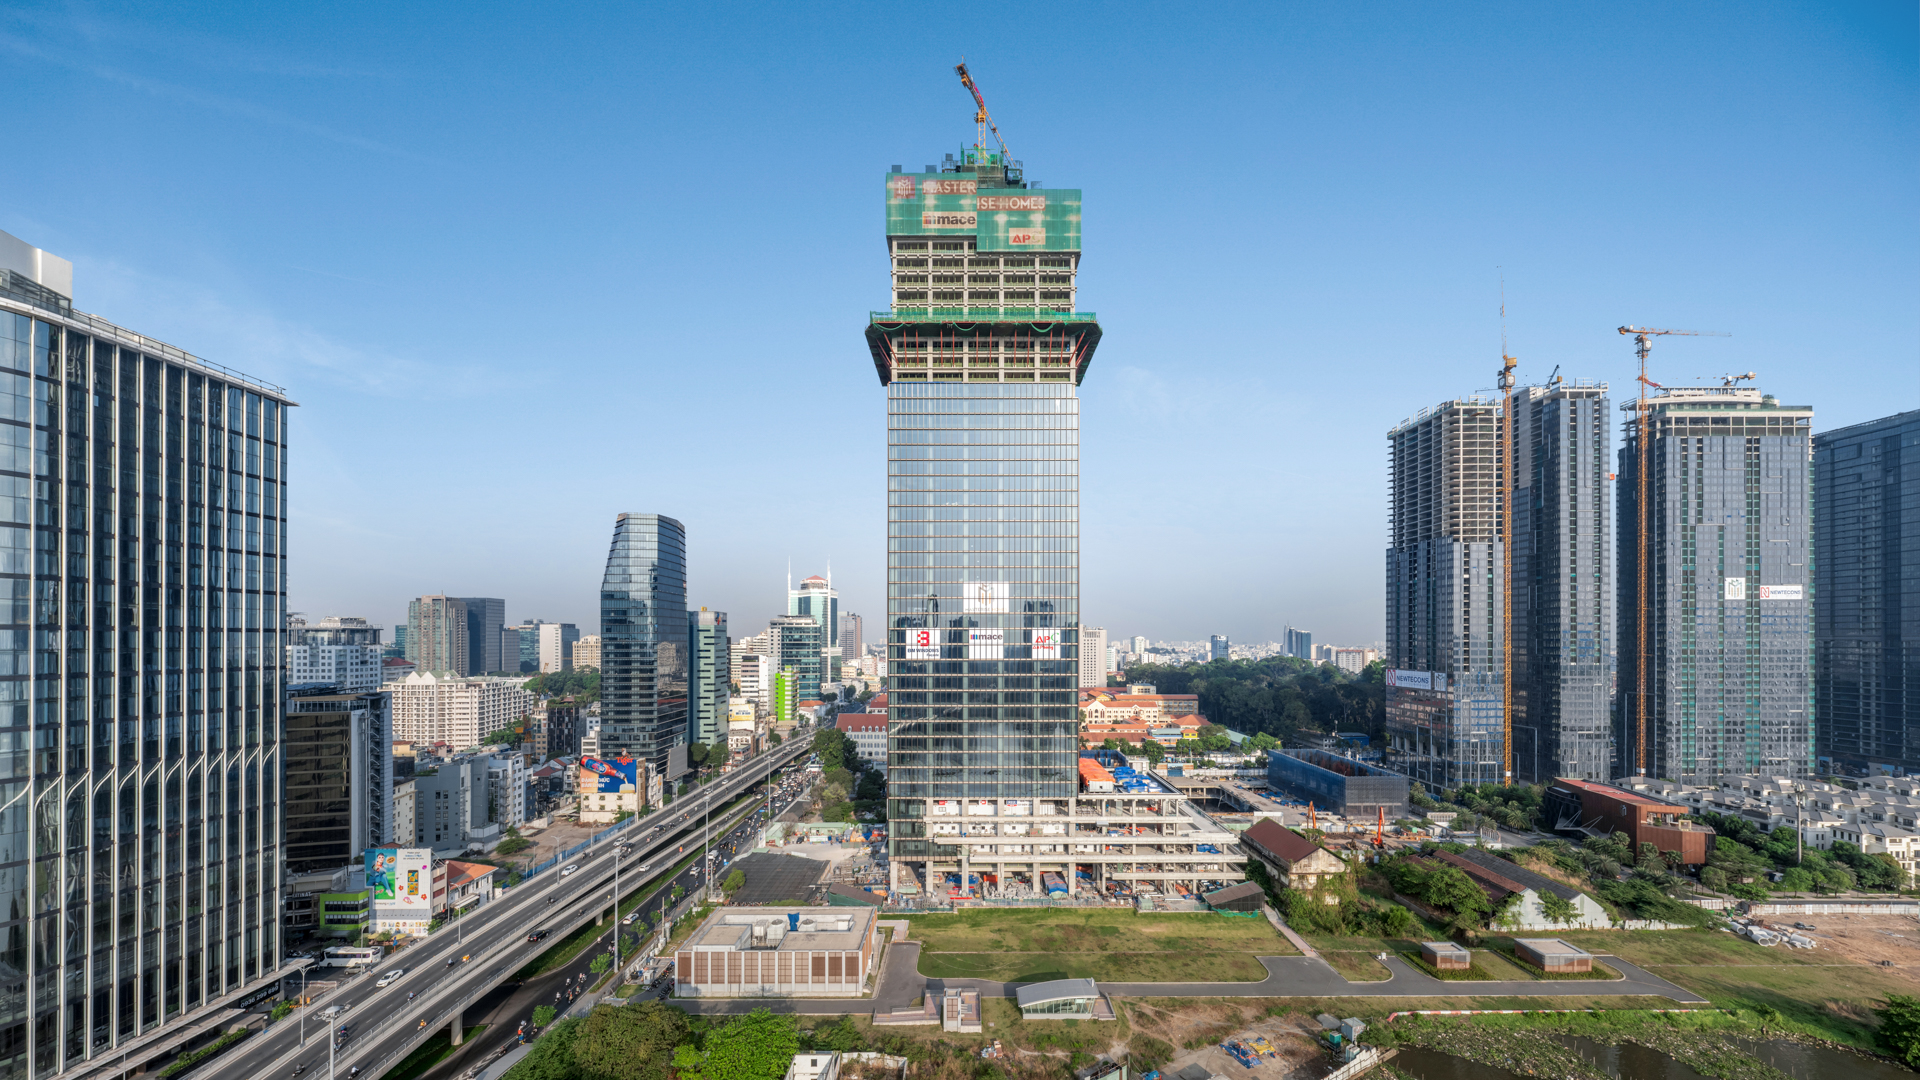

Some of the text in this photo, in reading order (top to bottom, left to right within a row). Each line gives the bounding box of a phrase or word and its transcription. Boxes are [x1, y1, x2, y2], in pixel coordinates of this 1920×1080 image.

[1000, 197, 1045, 209] HOMES
[937, 214, 976, 225] mace
[1396, 675, 1429, 684] NEWTECONS
[616, 757, 634, 765] Tiger
